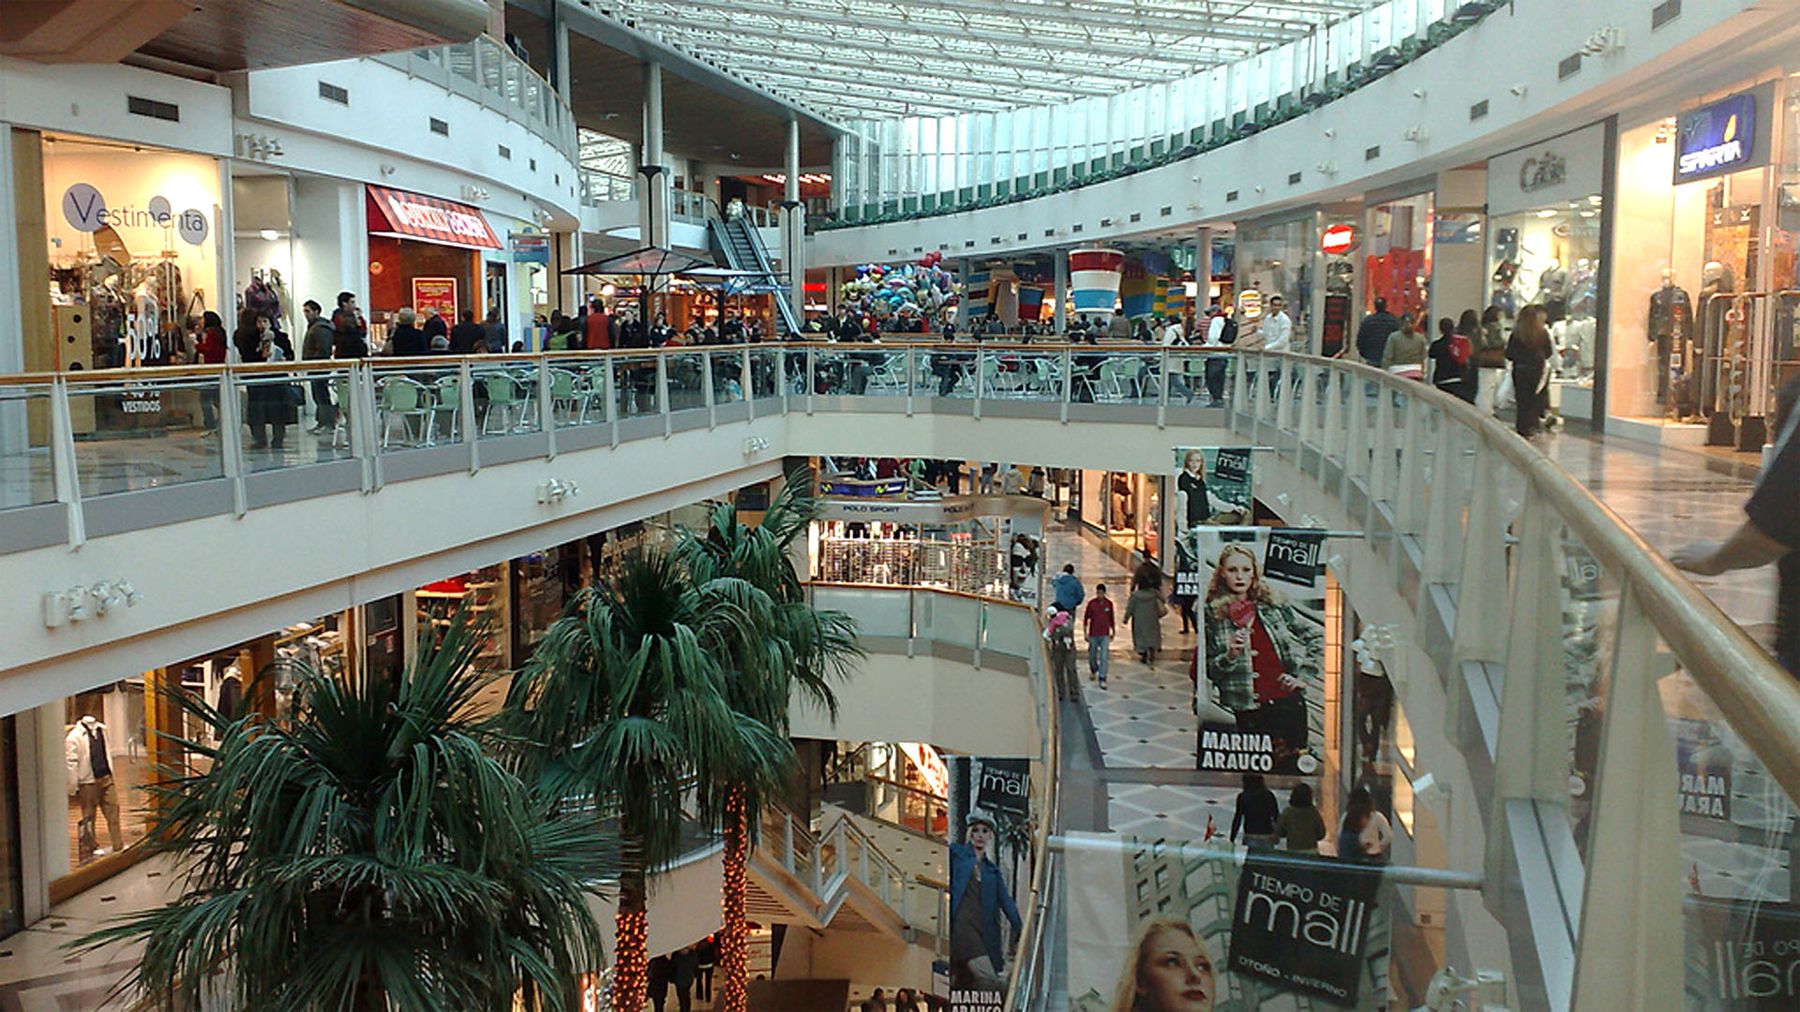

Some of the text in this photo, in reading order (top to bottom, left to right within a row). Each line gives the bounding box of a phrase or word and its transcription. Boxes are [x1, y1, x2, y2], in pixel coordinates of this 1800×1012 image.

[1680, 140, 1742, 173] SPARTA
[69, 191, 203, 232] Vestimenta
[121, 400, 161, 413] VESTIDOS
[843, 504, 900, 513] POLO SPORT
[1269, 543, 1318, 567] mall
[1202, 730, 1273, 752] MARINA
[1202, 751, 1273, 772] ARAUCO
[982, 773, 1030, 797] mall
[1252, 872, 1342, 913] TIEMPO DE
[1244, 890, 1366, 955] mall
[1239, 955, 1281, 978] OTOÑO
[1291, 973, 1348, 998] INVIERNO
[951, 989, 1003, 1005] MARINA
